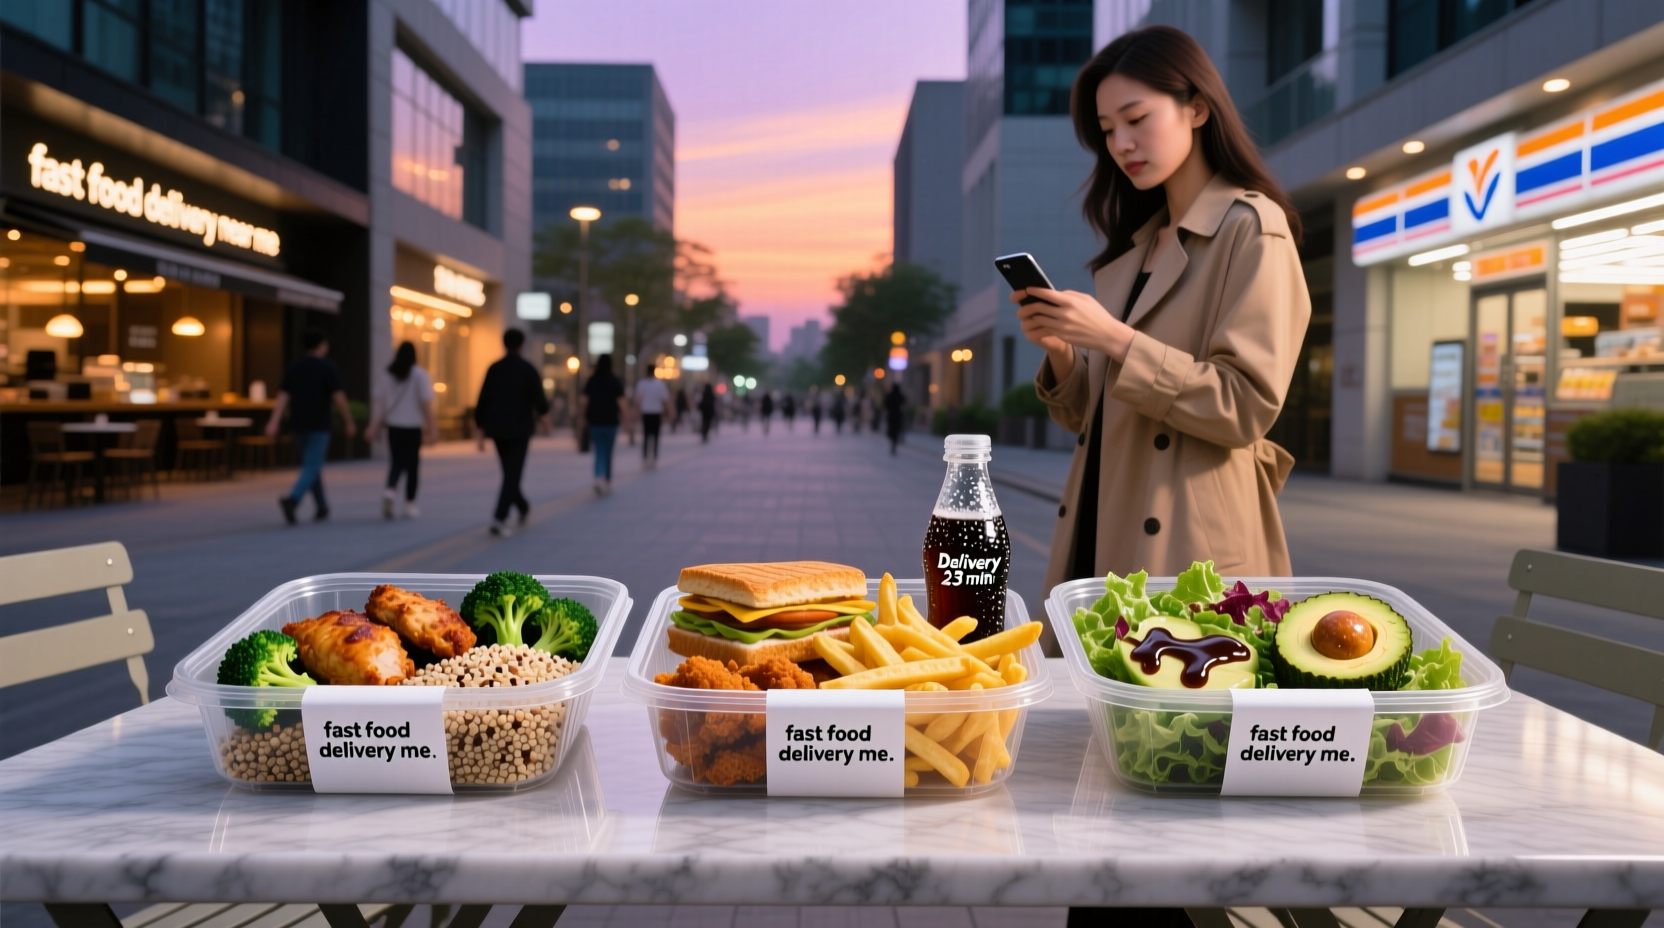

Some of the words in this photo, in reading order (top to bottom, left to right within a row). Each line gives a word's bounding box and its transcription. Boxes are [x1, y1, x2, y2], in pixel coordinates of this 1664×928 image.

[28, 143, 86, 200] fast
[87, 162, 144, 218] food
[937, 552, 1002, 574] Delivery
[940, 570, 964, 587] 23
[323, 721, 362, 738] fast
[365, 721, 410, 738] food
[785, 724, 823, 741] fast
[827, 724, 871, 741] food
[1250, 724, 1287, 741] fast
[1292, 724, 1336, 742] food
[319, 741, 396, 762] delivery
[400, 745, 437, 759] me.
[778, 745, 854, 766] delivery
[859, 749, 894, 762] me.
[1240, 745, 1316, 766] delivery
[1320, 749, 1355, 762] me.
